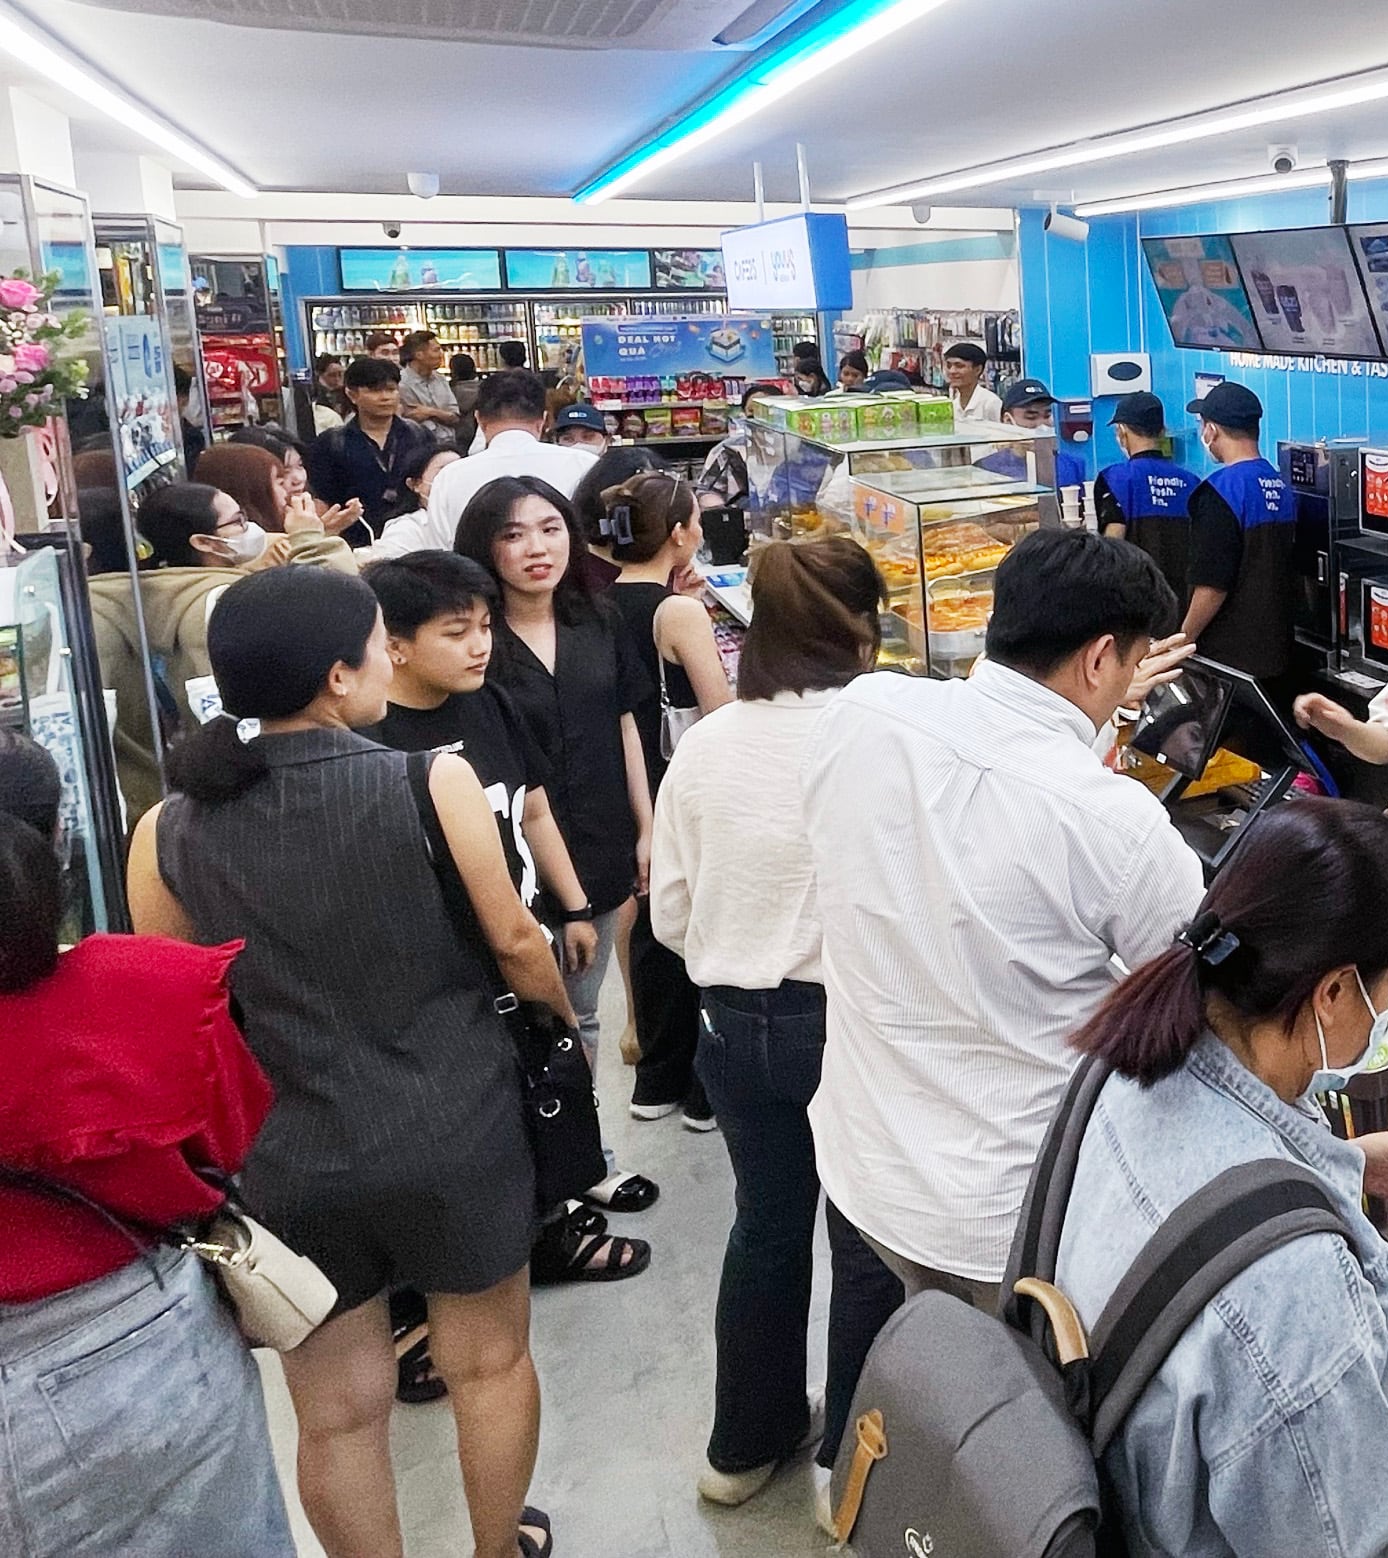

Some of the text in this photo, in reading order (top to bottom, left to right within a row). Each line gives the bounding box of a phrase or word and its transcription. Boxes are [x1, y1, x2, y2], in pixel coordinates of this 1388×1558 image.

[617, 334, 676, 344] DEAL HOT
[1263, 353, 1295, 372] MADE
